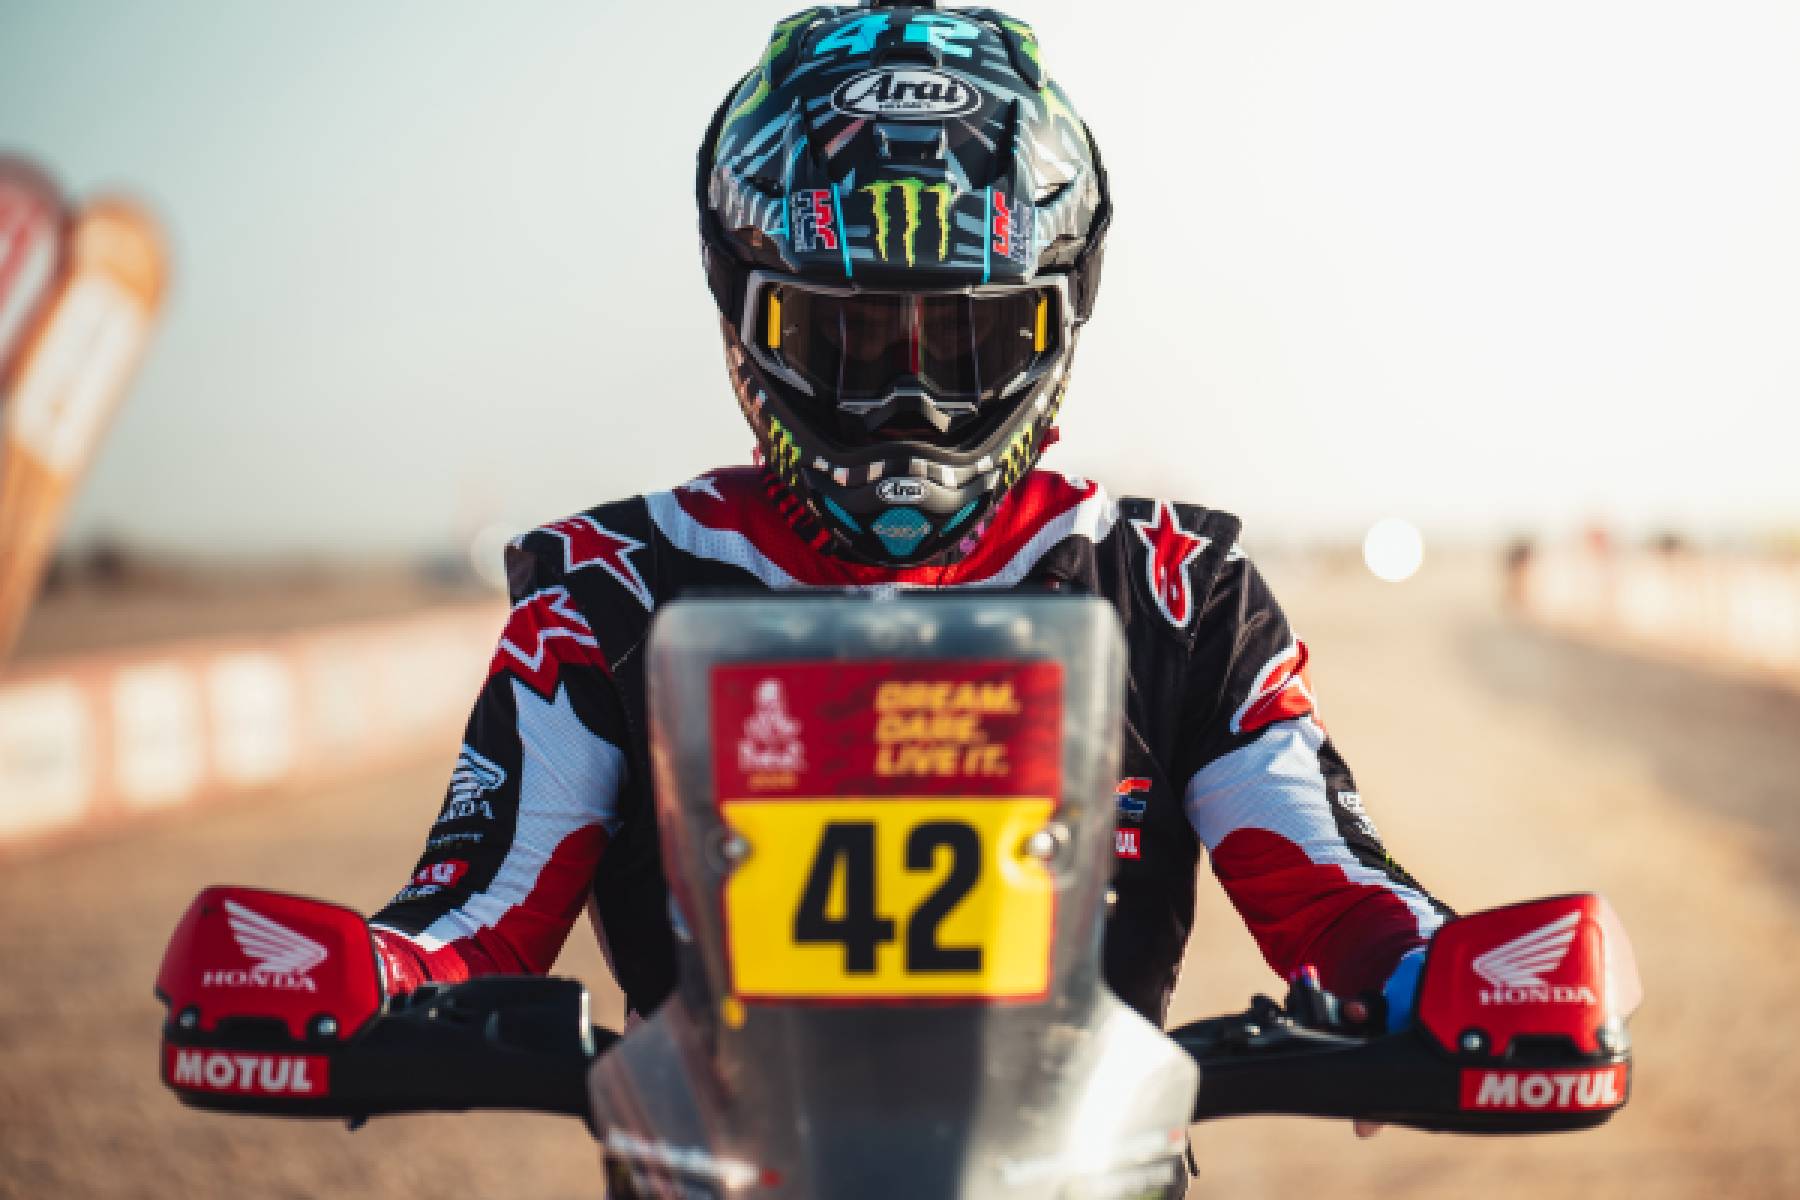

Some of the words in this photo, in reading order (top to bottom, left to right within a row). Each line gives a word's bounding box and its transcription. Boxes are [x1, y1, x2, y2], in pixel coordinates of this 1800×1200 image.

[814, 14, 981, 57] 42
[845, 73, 962, 105] Arai
[880, 481, 923, 497] Arai
[875, 680, 1021, 714] DREAM.
[875, 743, 957, 776] LIVE
[792, 820, 983, 976] 42
[203, 968, 318, 993] HONDA
[1478, 985, 1598, 1006] HONDA
[174, 1049, 312, 1093] MOTUL
[1475, 1070, 1619, 1108] MOTUL
